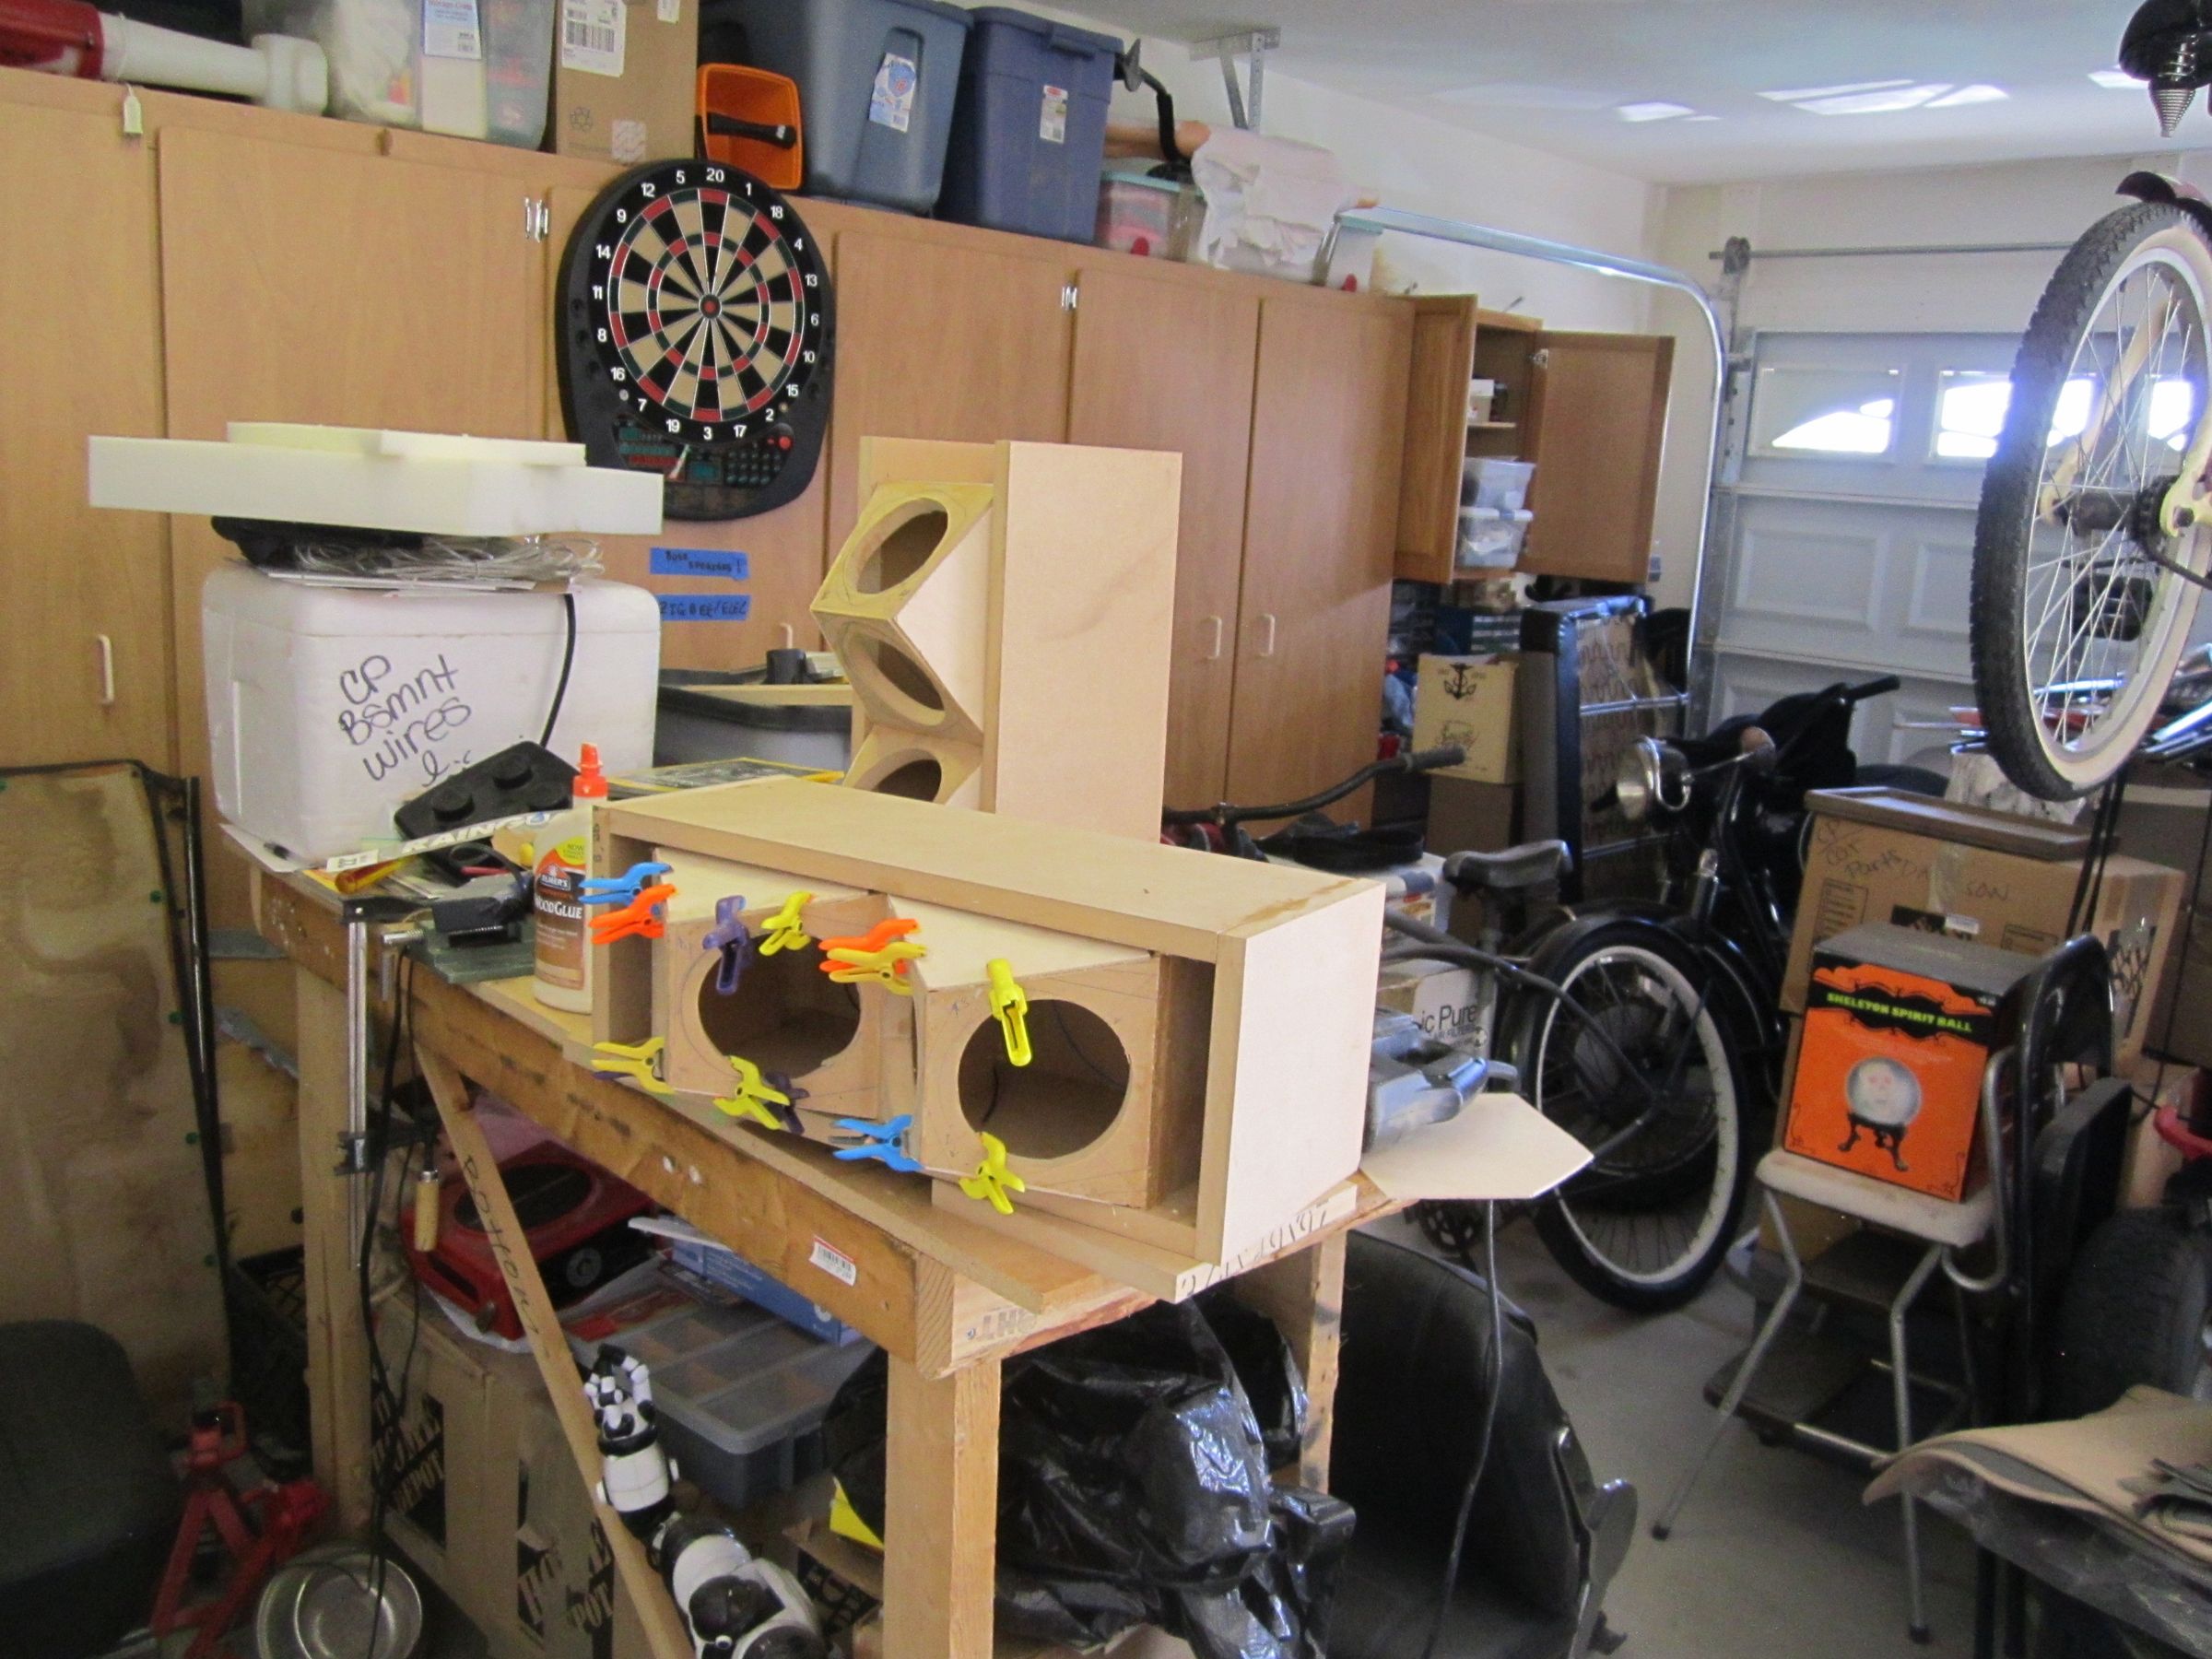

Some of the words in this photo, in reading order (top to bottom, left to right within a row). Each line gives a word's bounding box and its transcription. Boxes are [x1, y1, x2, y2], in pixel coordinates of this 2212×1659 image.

[677, 171, 685, 183] 5
[707, 168, 724, 182] 20
[641, 183, 654, 197] 12
[747, 183, 751, 195] 1
[617, 209, 626, 222] 9
[771, 206, 782, 218] 18
[794, 239, 802, 250] 4
[596, 244, 611, 259] 14
[806, 274, 818, 287] 13
[593, 286, 602, 300] 11
[811, 314, 818, 325] 6
[597, 328, 606, 342] 8
[804, 351, 815, 362] 10
[611, 367, 625, 381] 16
[786, 384, 798, 396] 15
[639, 398, 647, 411] 7
[766, 408, 773, 421] 2
[666, 419, 680, 432] 19
[734, 425, 747, 437] 17
[704, 427, 712, 440] 3
[340, 655, 392, 704] CP
[541, 875, 569, 888] ELMER'S
[1439, 1005, 1477, 1030] Pure
[1826, 992, 1889, 1015] SKELETON
[1891, 1006, 1936, 1024] SPIRIT
[1936, 1016, 1972, 1033] BALL
